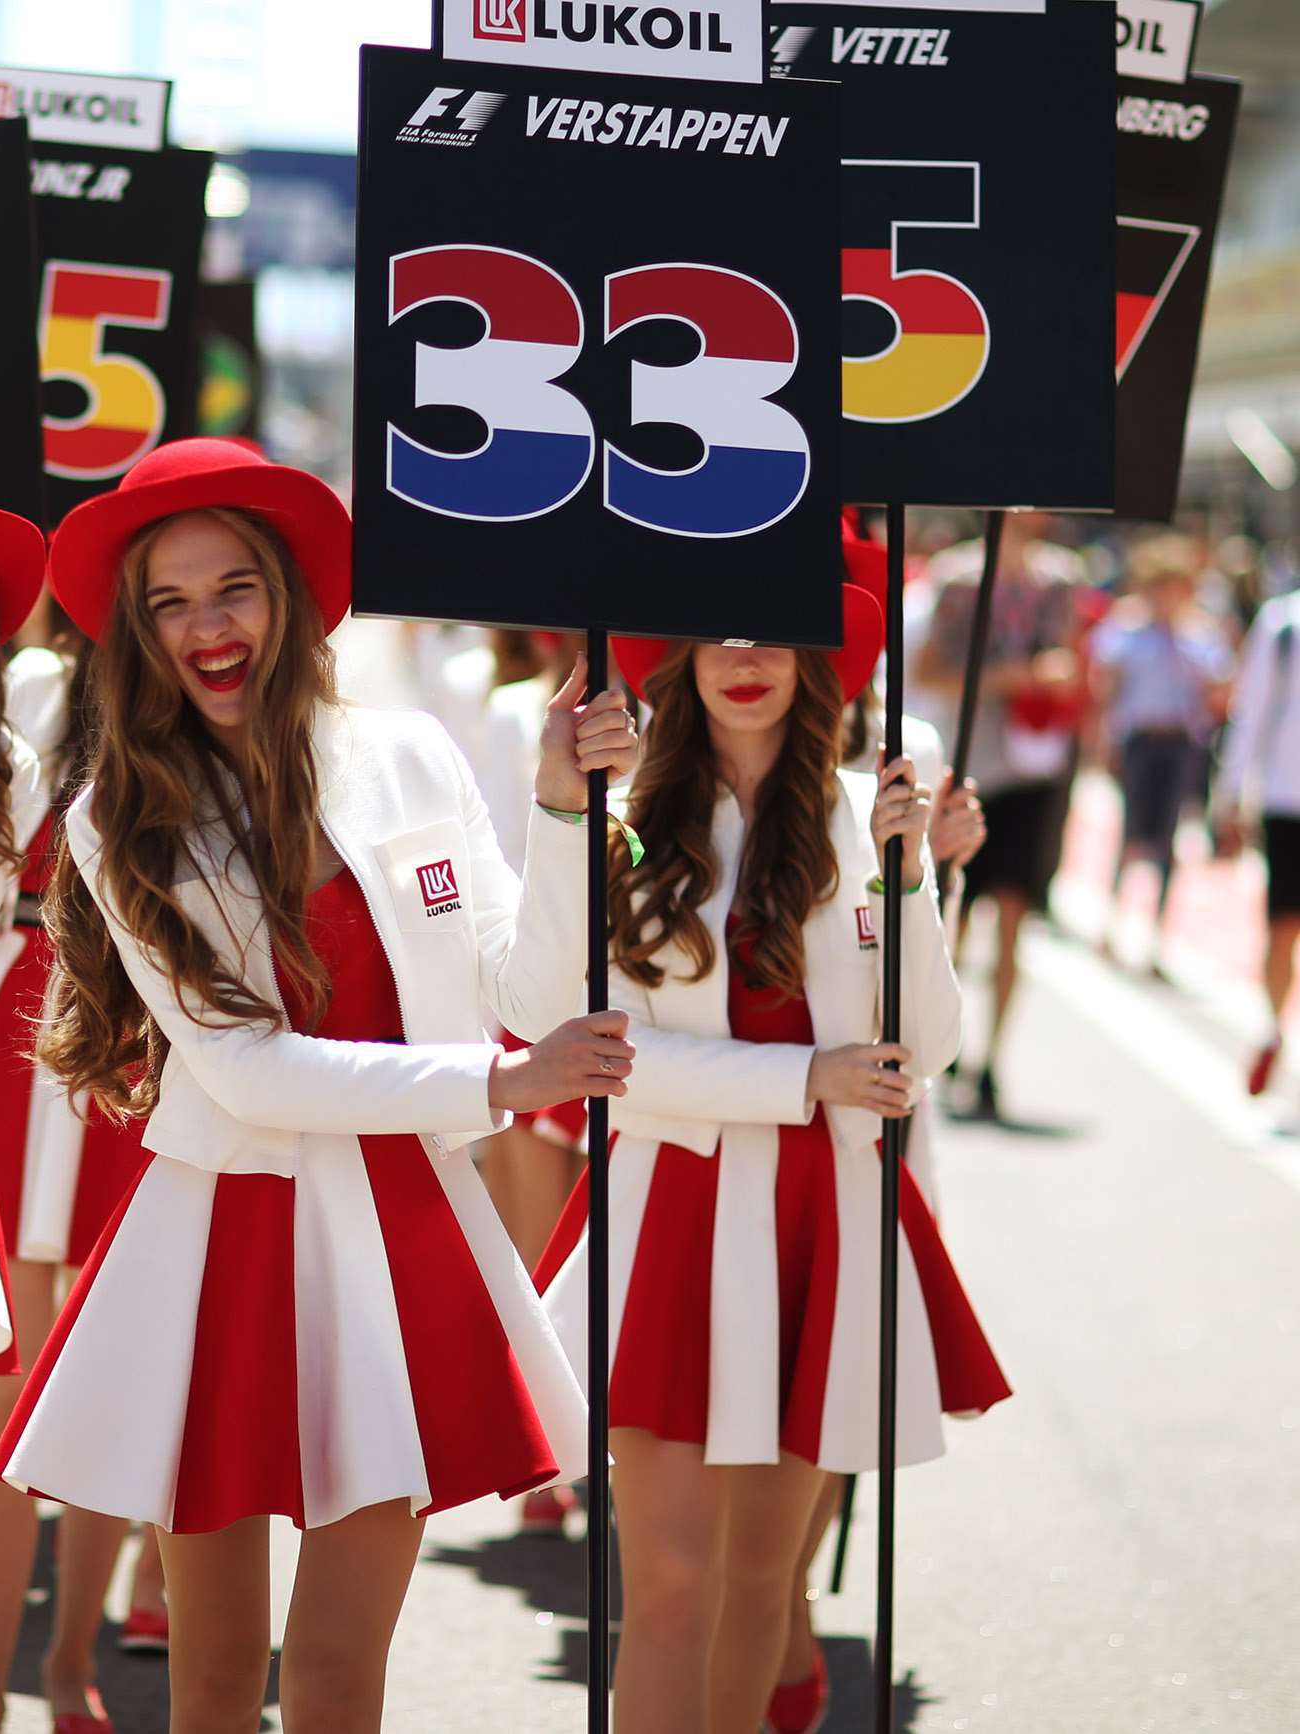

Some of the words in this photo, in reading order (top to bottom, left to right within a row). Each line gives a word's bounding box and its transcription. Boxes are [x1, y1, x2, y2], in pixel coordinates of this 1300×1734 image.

[534, 0, 732, 53] LUKOIL
[831, 27, 951, 66] VETTEL
[15, 88, 141, 126] LUKOIL
[406, 86, 508, 131] F1
[526, 95, 790, 157] VERSTAPPEN
[399, 126, 420, 136] FIA
[421, 128, 469, 141] Formula
[386, 243, 811, 538] 33
[426, 900, 462, 918] LUKOIL
